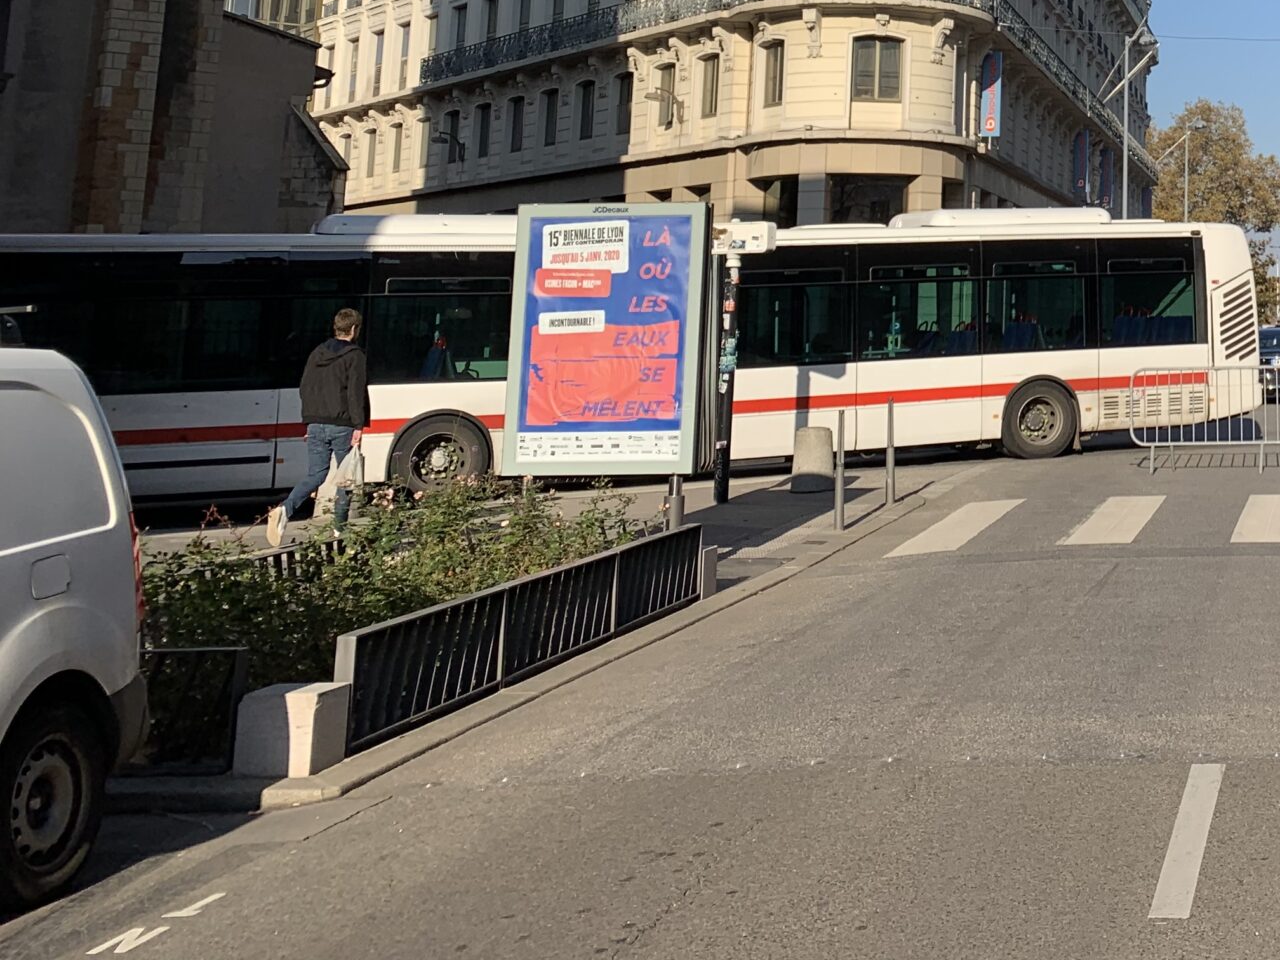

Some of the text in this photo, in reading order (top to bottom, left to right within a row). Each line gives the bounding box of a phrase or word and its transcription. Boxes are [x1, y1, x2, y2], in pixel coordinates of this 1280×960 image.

[592, 206, 629, 214] JCDecaux
[563, 228, 595, 242] BIENNALE
[597, 227, 606, 240] DE
[607, 226, 624, 239] LYON
[643, 225, 671, 247] LÀ
[604, 250, 620, 261] 2020
[639, 257, 672, 280] OÙ
[628, 295, 669, 313] LES
[612, 330, 669, 347] EAUX
[638, 367, 665, 383] SE
